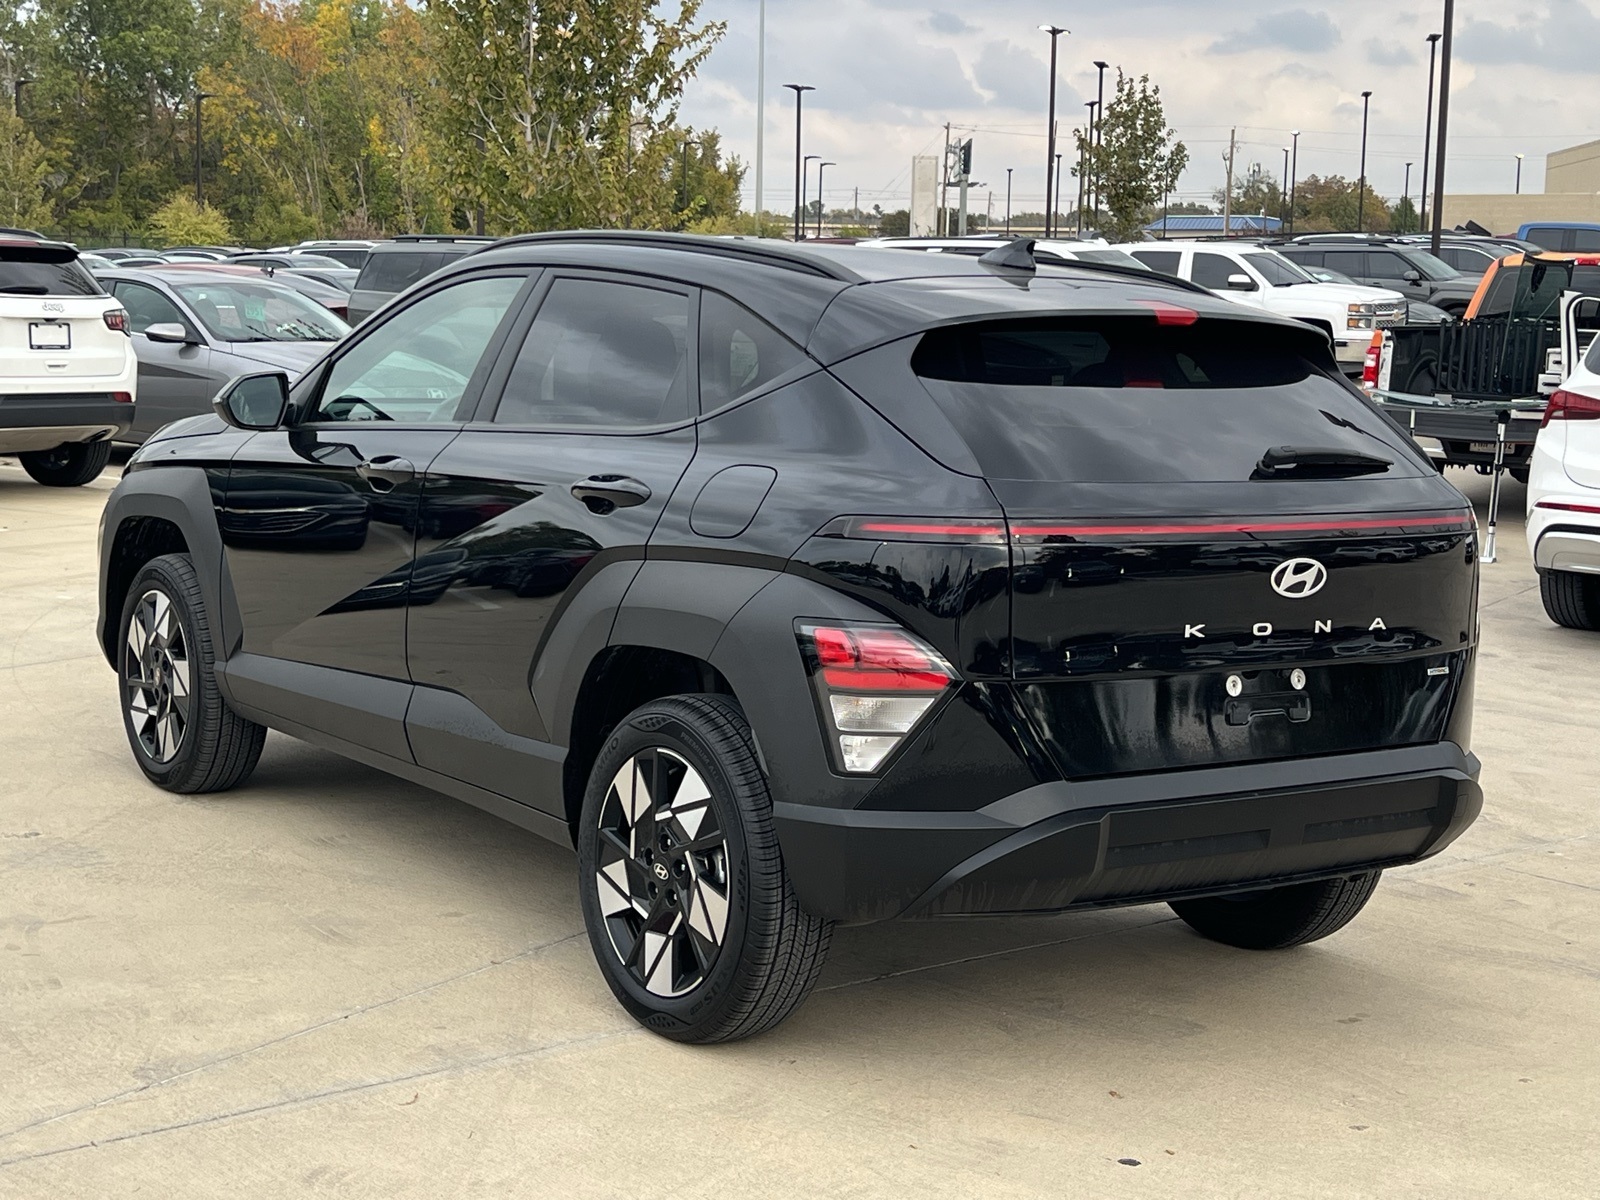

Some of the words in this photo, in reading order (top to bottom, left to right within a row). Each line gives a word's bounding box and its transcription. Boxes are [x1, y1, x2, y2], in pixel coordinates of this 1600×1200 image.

[41, 301, 65, 313] Jeep
[1184, 617, 1387, 638] KONA
[680, 731, 710, 764] PREMIUM
[708, 765, 719, 784] ALL
